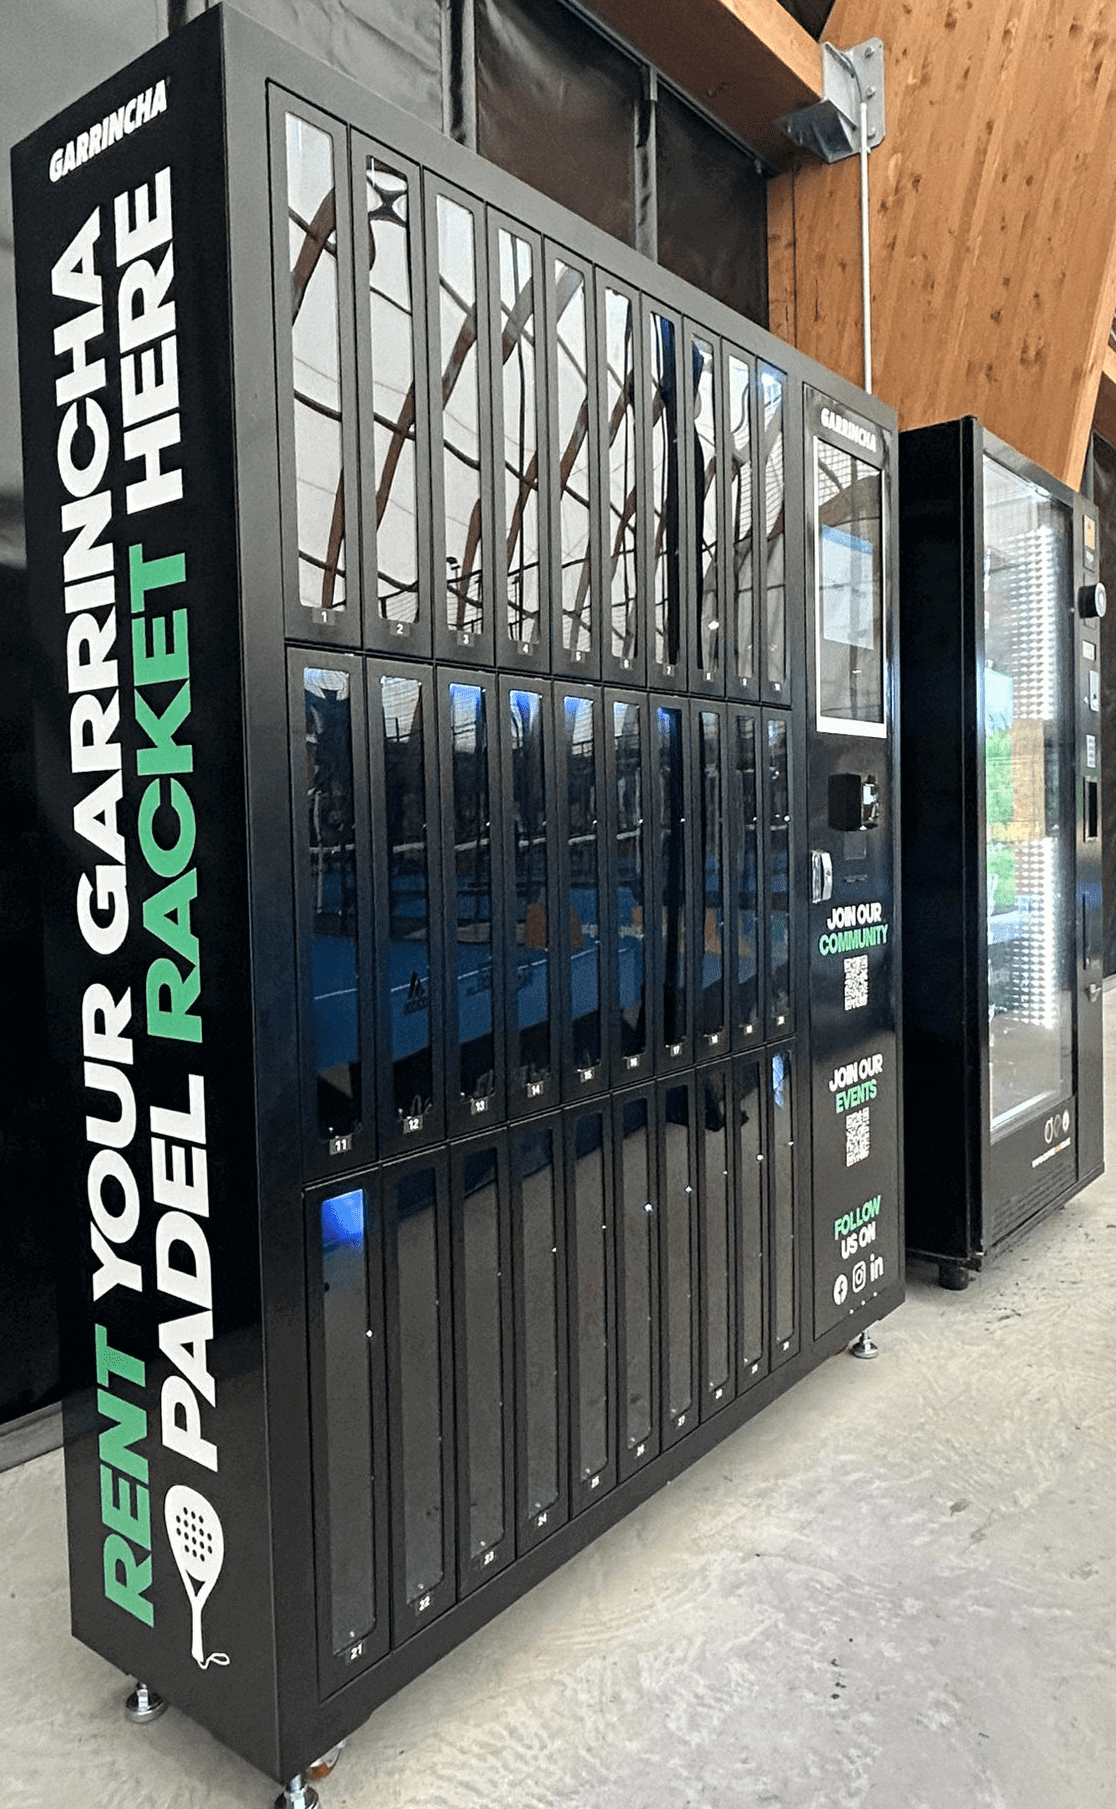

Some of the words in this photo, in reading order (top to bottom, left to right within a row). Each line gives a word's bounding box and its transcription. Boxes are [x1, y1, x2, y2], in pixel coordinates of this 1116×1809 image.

[49, 80, 167, 183] GARRINCHA
[114, 166, 184, 515] HERE
[51, 205, 130, 955] GARRINCHA
[320, 611, 328, 623] 1
[396, 623, 404, 635] 2
[462, 634, 470, 645] 3
[128, 543, 203, 1044] RACKET
[827, 906, 857, 931] JOIN
[856, 902, 883, 925] OUR
[819, 923, 888, 956] COMMUNITY
[829, 1061, 859, 1092] JOIN
[858, 1053, 883, 1080] OUR
[475, 1100, 486, 1112] 13
[530, 1084, 541, 1096] 14
[835, 1078, 877, 1114] EVENTS
[408, 1118, 420, 1131] 12
[81, 982, 143, 1302] YOUR
[335, 1138, 348, 1152] 11
[834, 1194, 881, 1240] FOLLOW
[841, 1232, 858, 1260] US
[858, 1220, 876, 1248] ON
[149, 1073, 218, 1473] PADEL
[869, 1252, 884, 1282] in
[95, 1323, 154, 1628] RENT
[419, 1595, 431, 1611] 22
[350, 1643, 363, 1660] 21
